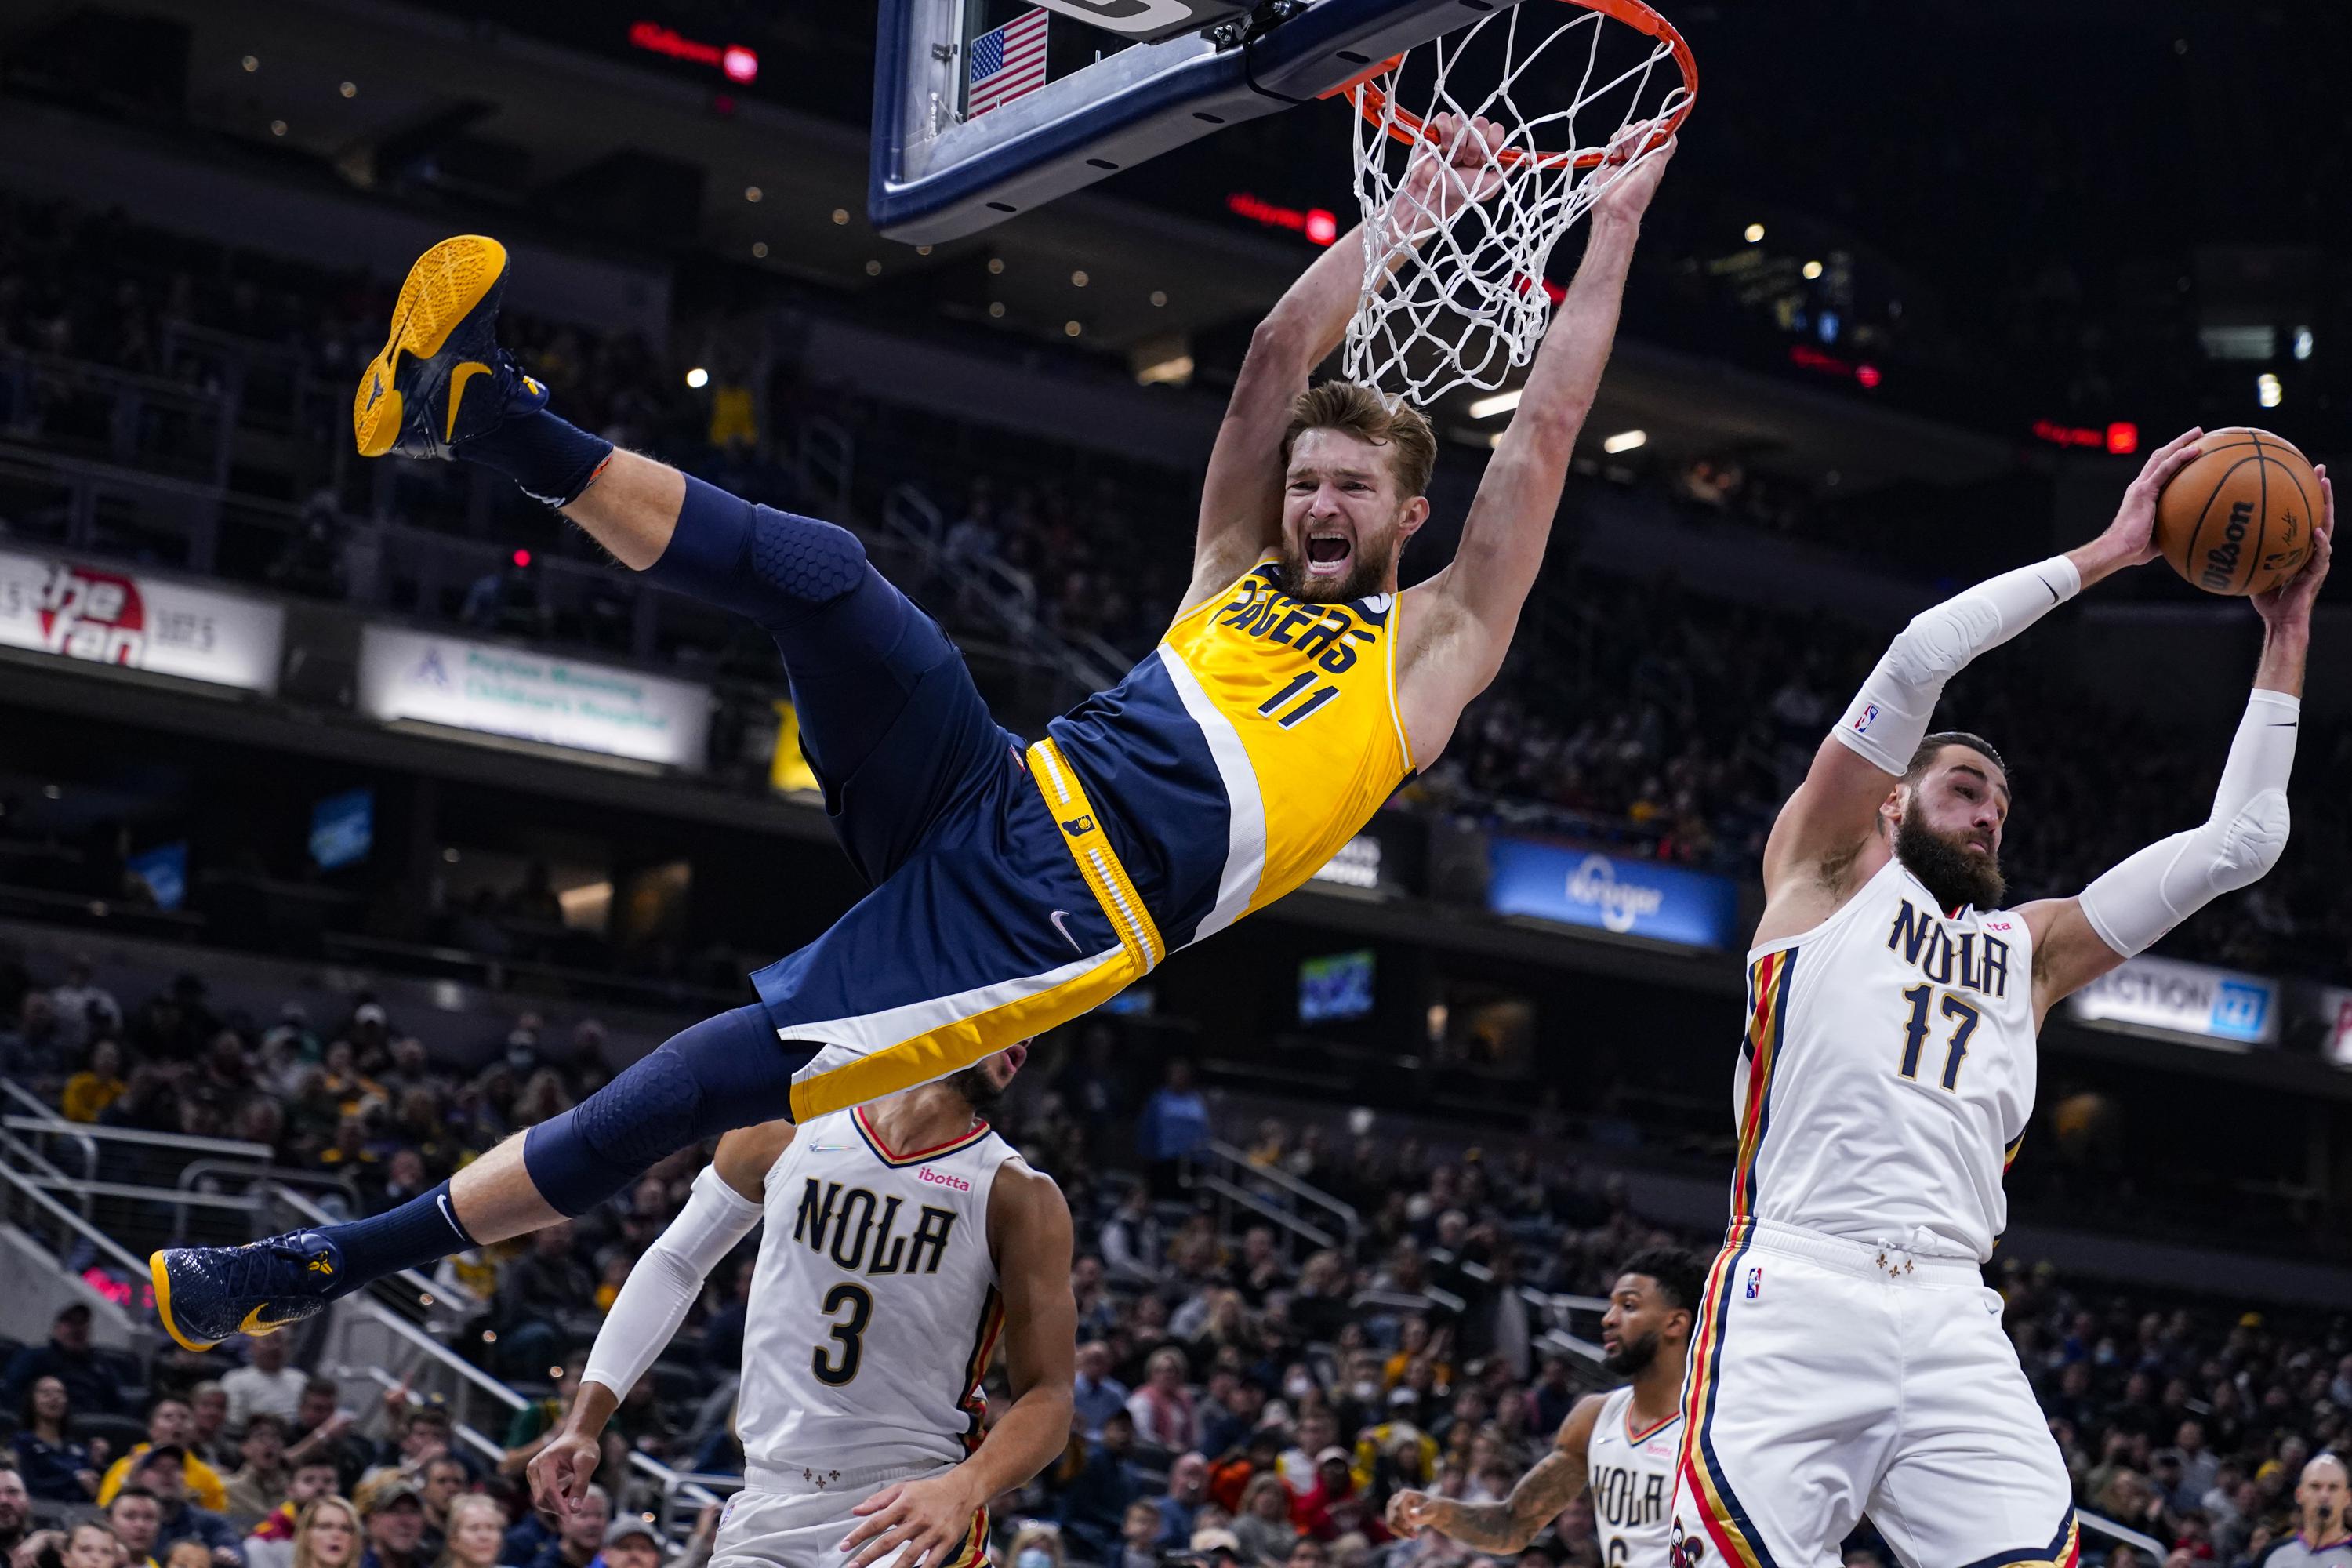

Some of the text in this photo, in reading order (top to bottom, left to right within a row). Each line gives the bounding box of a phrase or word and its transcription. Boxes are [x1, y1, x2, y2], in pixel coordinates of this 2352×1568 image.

[2201, 500, 2255, 590] Wilson
[49, 608, 145, 669] fan
[1207, 580, 1376, 674] PACERS
[1257, 670, 1341, 731] 11
[1566, 852, 1663, 934] Kroger
[1886, 896, 2009, 1000] NOLA
[1898, 982, 1980, 1094] 17
[918, 1167, 970, 1192] ibotta
[793, 1176, 958, 1276] NOLA
[811, 1281, 873, 1387] 3
[1594, 1465, 1666, 1528] NOLA
